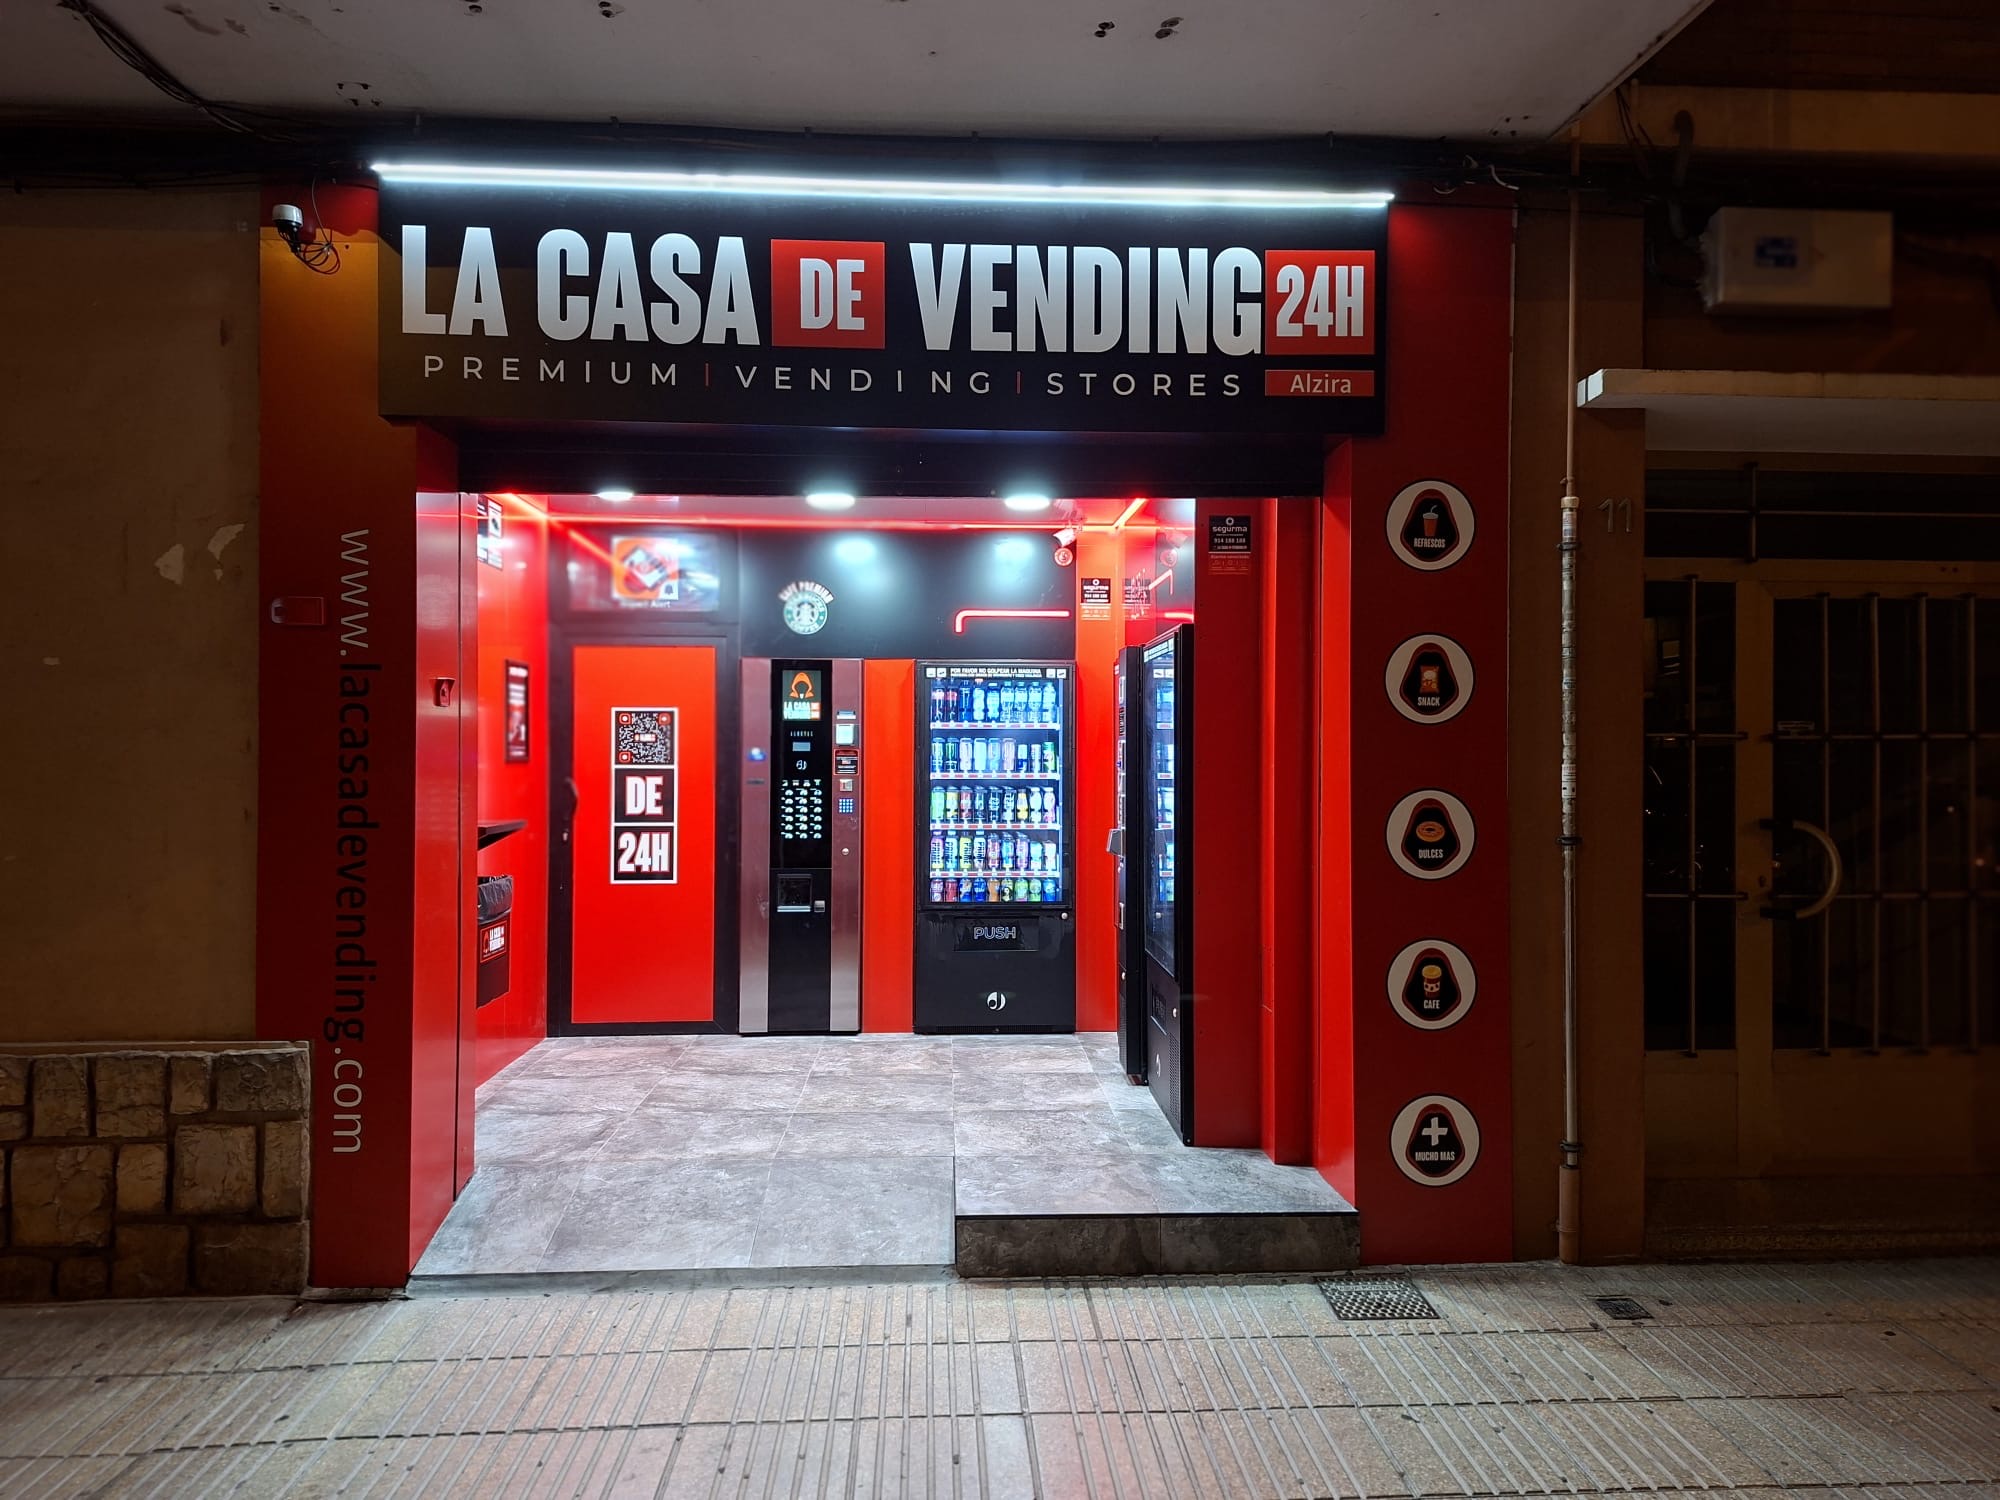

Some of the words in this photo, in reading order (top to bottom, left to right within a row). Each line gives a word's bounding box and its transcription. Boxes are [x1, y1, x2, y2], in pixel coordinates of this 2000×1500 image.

[401, 224, 509, 337] LA
[537, 228, 761, 346] CASA
[800, 257, 866, 331] DE
[909, 242, 1263, 357] VENDING
[1275, 264, 1365, 338] 24H
[423, 355, 677, 387] PREMIUM
[734, 364, 991, 395] VENDING
[1046, 372, 1241, 398] STORES
[1289, 374, 1353, 396] Alzira
[1597, 496, 1632, 533] 11
[1212, 526, 1248, 534] segurma
[1413, 537, 1446, 549] REFRESCOS
[1417, 696, 1441, 707] SNACK
[625, 776, 663, 816] DE
[323, 528, 382, 1155] www.lacasadevending.com
[617, 831, 671, 873] 24H
[1418, 848, 1444, 859] DULCES
[973, 926, 1017, 940] PUSH
[1423, 999, 1441, 1009] CAFE
[1415, 1151, 1439, 1162] MUCHO
[1440, 1151, 1456, 1161] MAS
